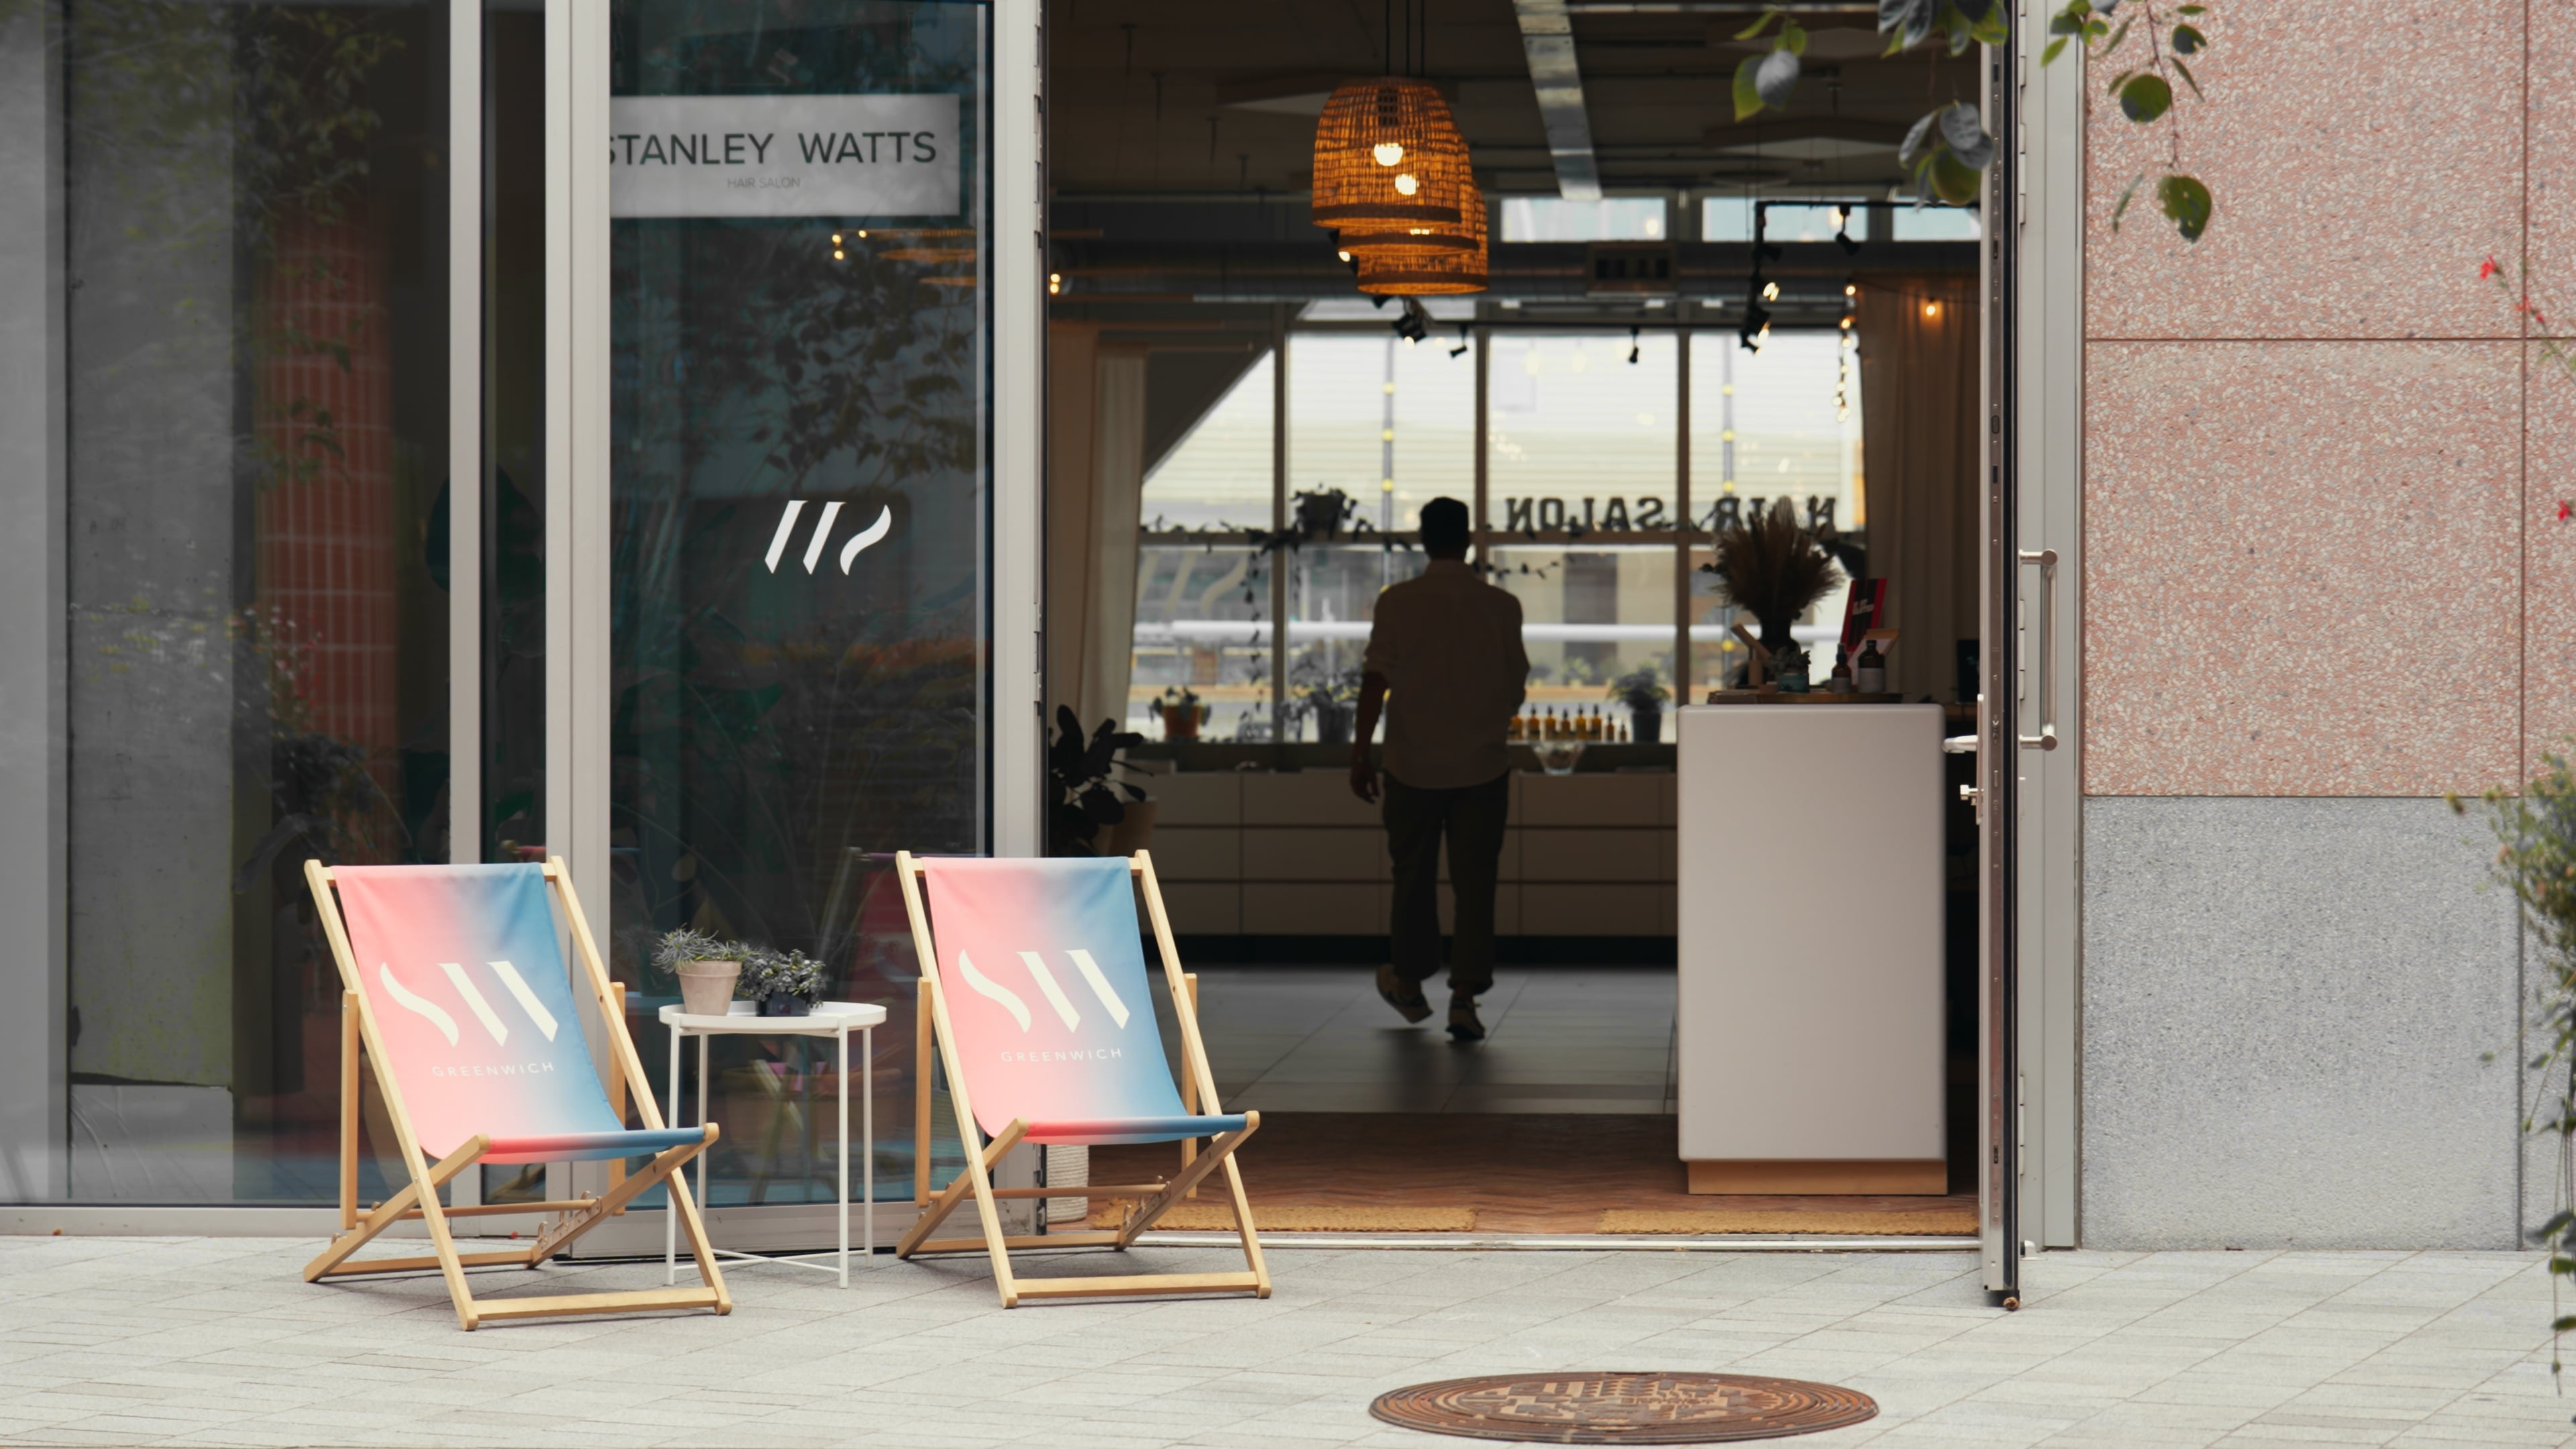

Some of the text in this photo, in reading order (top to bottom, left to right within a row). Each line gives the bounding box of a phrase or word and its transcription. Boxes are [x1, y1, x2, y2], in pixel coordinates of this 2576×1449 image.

[798, 131, 937, 164] WATTS
[727, 176, 800, 189] HAIR SALON
[1000, 1047, 1122, 1063] GREENWICH
[431, 1061, 555, 1077] GREENWICH
